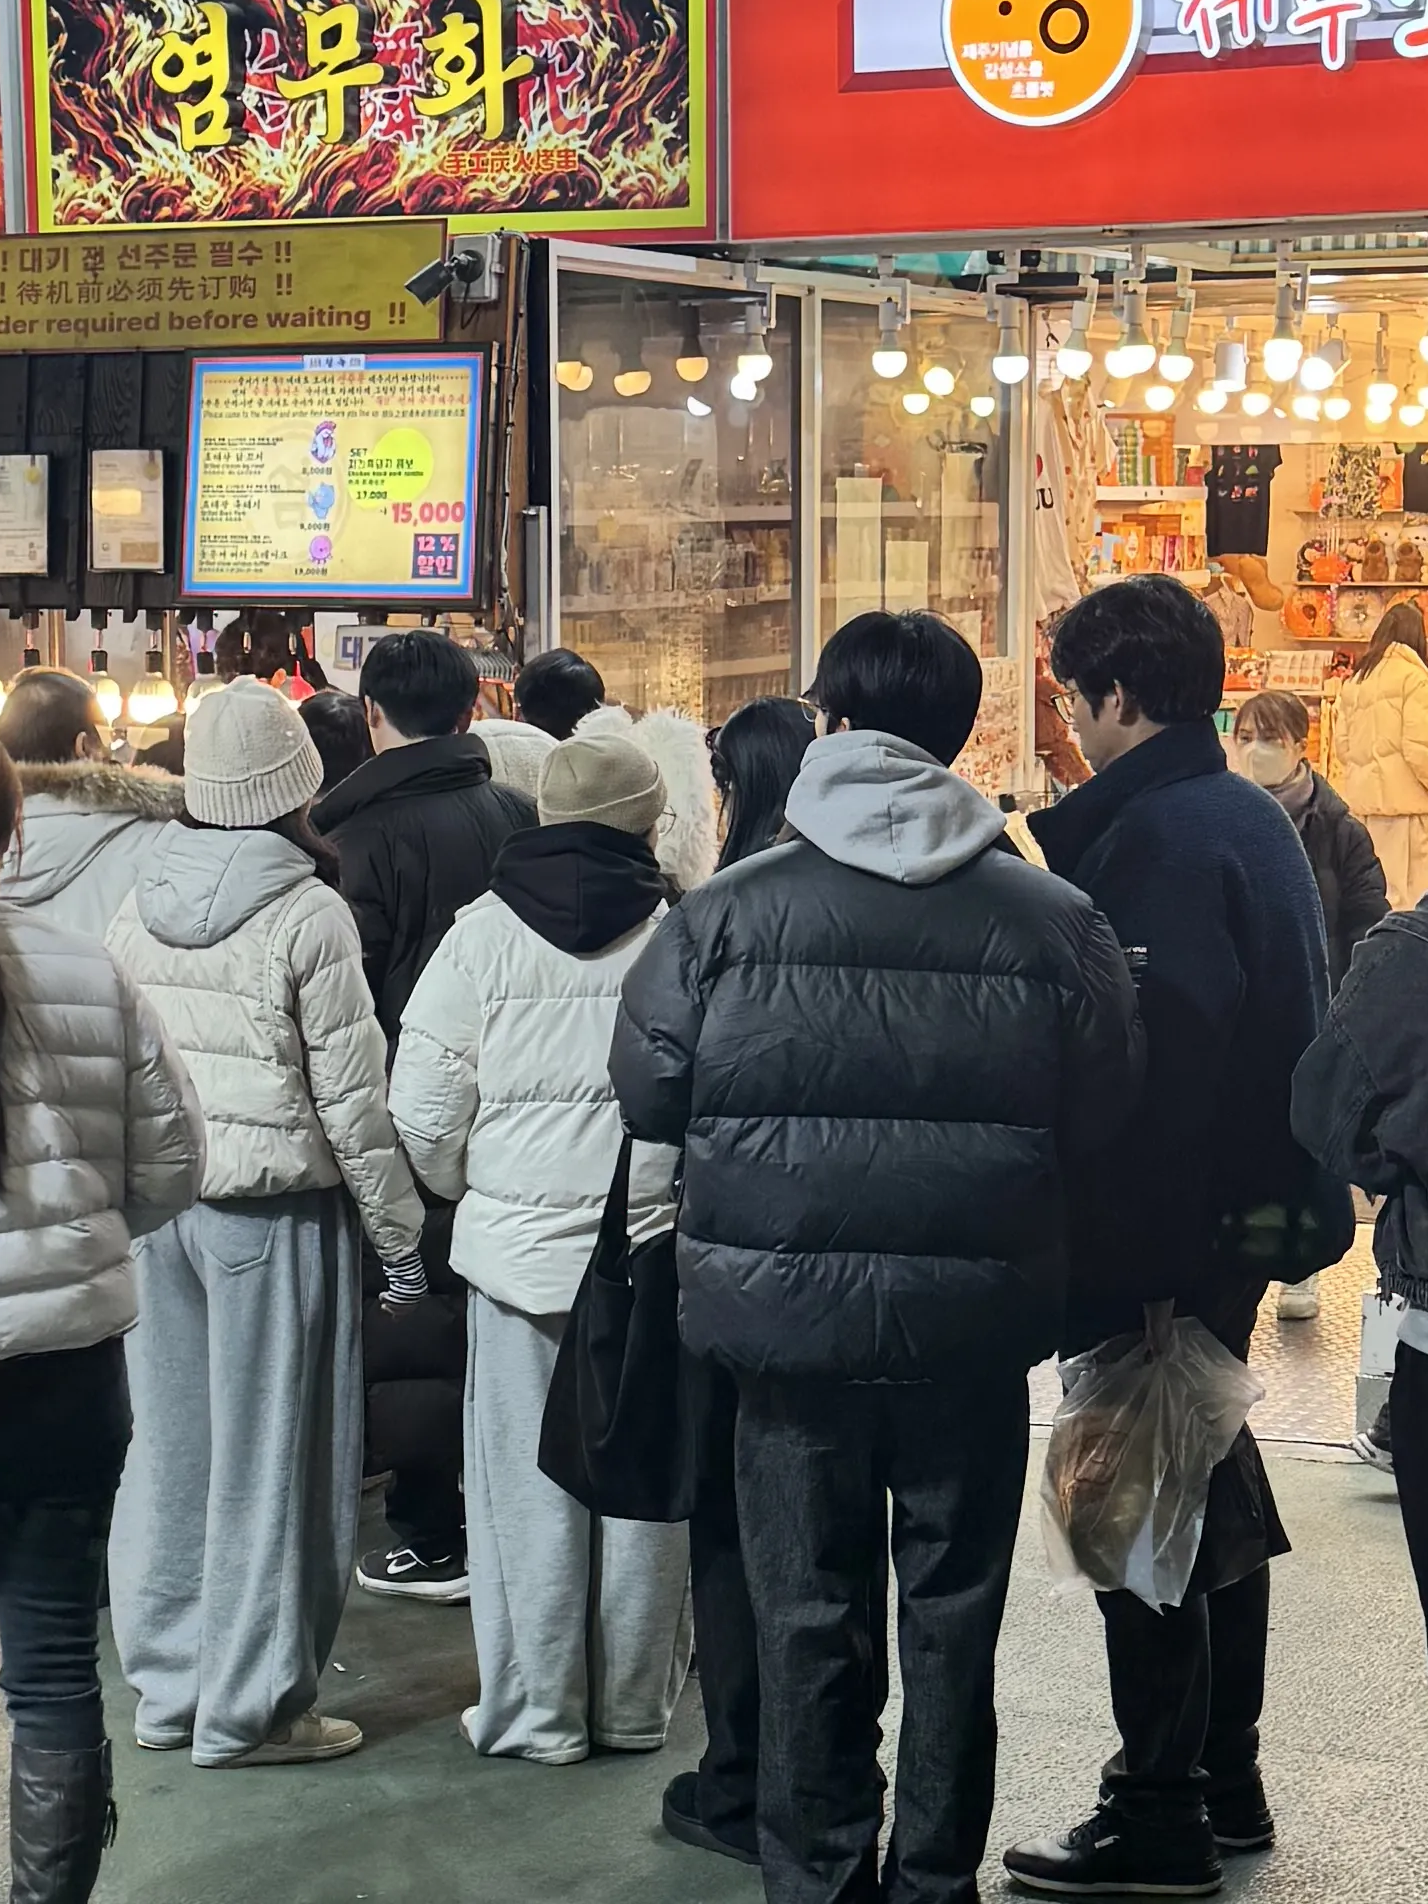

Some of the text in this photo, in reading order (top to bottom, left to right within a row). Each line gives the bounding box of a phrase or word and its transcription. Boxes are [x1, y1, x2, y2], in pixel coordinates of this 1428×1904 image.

[19, 245, 70, 273] 대기
[116, 241, 199, 270] 선주문
[209, 241, 264, 268] 필수
[16, 274, 258, 306] 待机前必须先订购
[45, 308, 161, 338] required
[168, 305, 259, 332] before
[266, 302, 371, 332] waiting
[392, 501, 465, 527] 15,000
